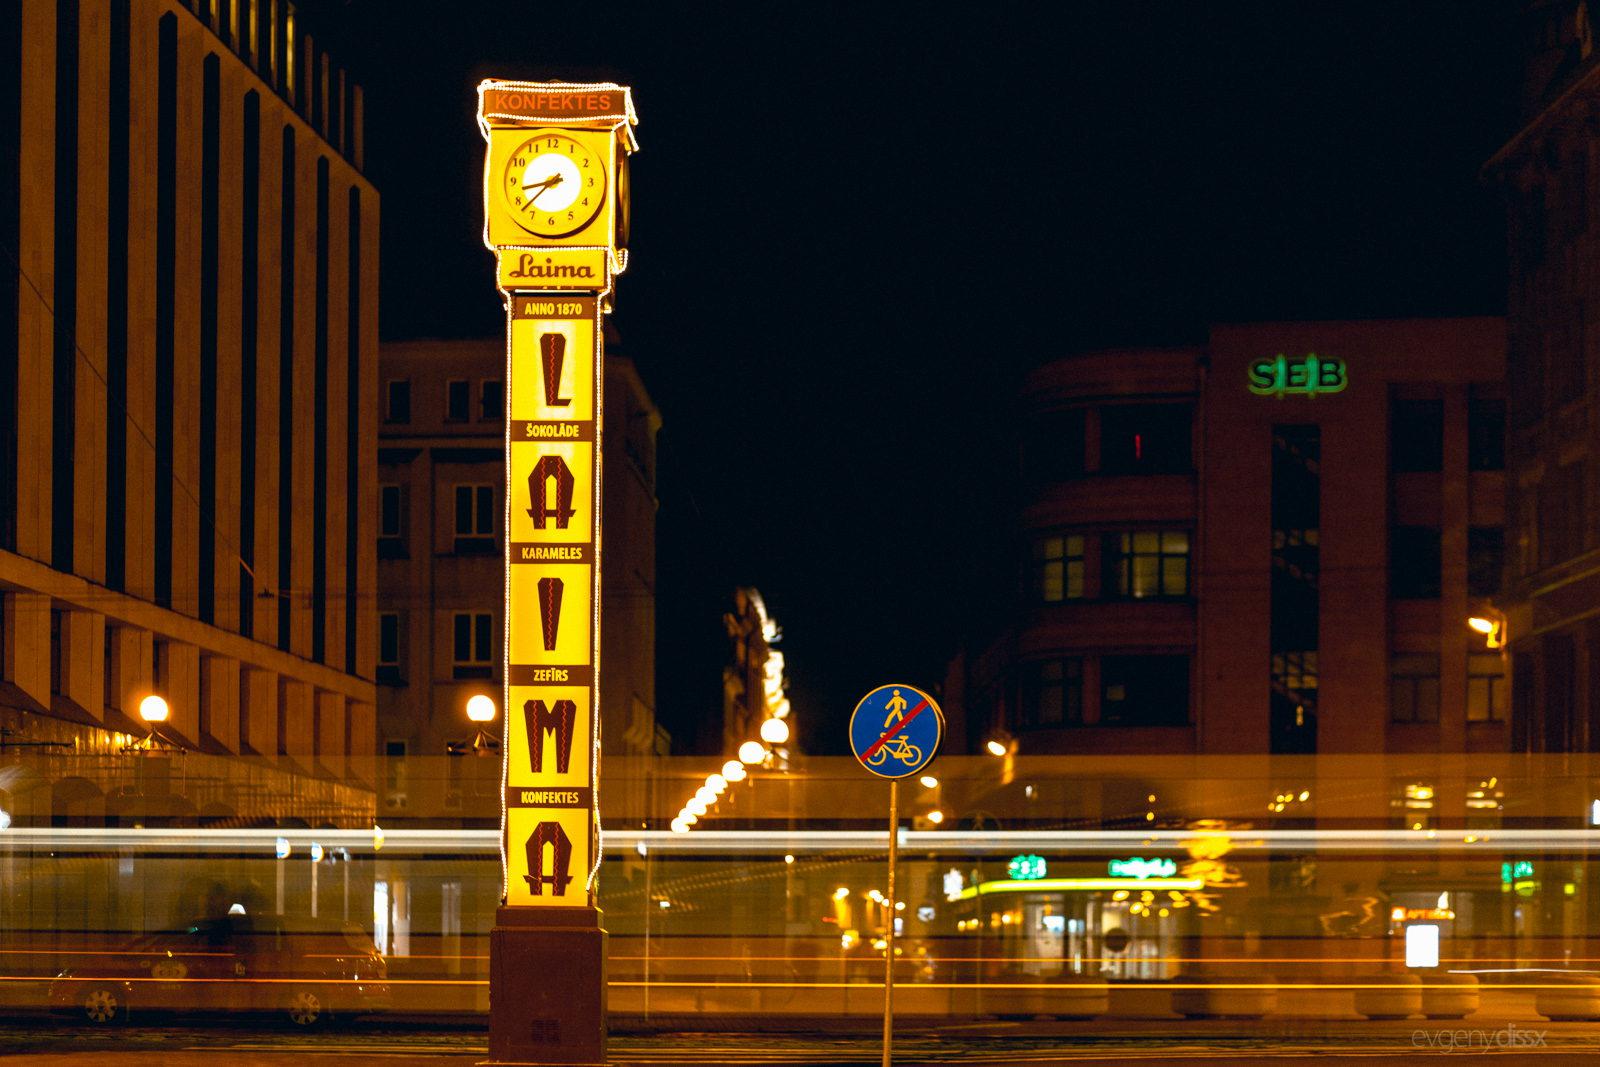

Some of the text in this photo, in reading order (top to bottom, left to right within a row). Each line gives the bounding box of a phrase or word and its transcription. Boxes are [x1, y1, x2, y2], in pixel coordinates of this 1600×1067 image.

[495, 94, 611, 110] KONFEKTES
[547, 139, 559, 148] 12
[528, 144, 539, 153] 11
[570, 144, 574, 153] 1
[513, 158, 525, 167] 10
[583, 158, 589, 168] 2
[510, 177, 517, 186] 9
[588, 178, 594, 187] 3
[515, 197, 521, 206] 8
[581, 197, 588, 206] 4
[529, 211, 535, 220] 7
[568, 211, 574, 220] 5
[548, 217, 555, 226] 6
[509, 253, 595, 278] Laima
[525, 303, 583, 315] ANNO 1870
[1250, 356, 1346, 394] SEB
[526, 423, 579, 437] ŠOKOLĀDE
[522, 547, 583, 560] KARAMELES
[533, 667, 569, 682] ZEFĪRS
[521, 791, 579, 804] KONFEKTES
